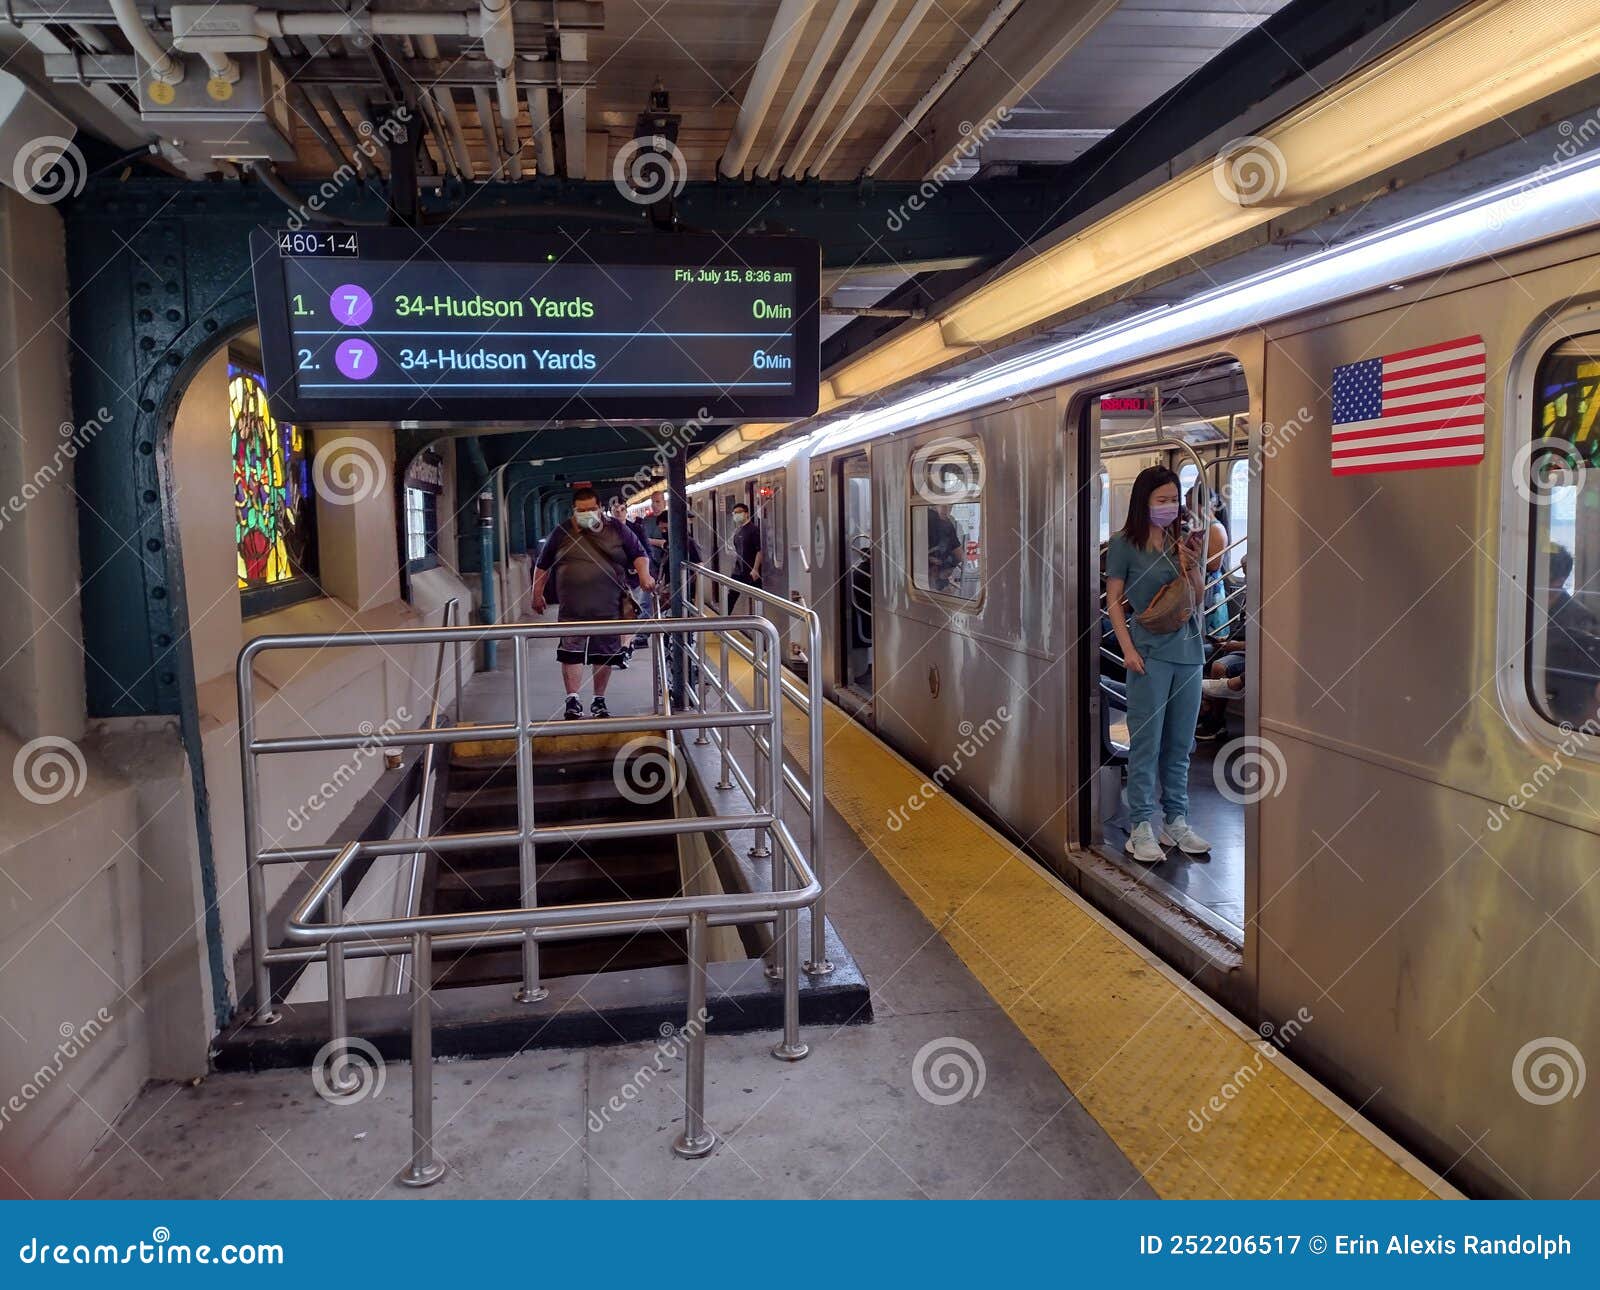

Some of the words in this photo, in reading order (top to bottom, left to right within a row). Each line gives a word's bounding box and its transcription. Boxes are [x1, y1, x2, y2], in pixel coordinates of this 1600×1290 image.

[280, 234, 357, 252] 460-1-4
[674, 269, 695, 283] Fri,
[697, 269, 721, 284] July
[724, 270, 742, 283] 15,
[745, 270, 771, 282] 8:36
[773, 272, 792, 282] am
[293, 294, 315, 316] 1.
[343, 295, 358, 315] 7
[395, 296, 523, 317] 34-Hudson
[530, 297, 594, 317] Yards
[298, 349, 320, 369] 2.
[349, 349, 363, 369] 7
[400, 349, 526, 369] 34-Hudson
[533, 350, 596, 369] Yards
